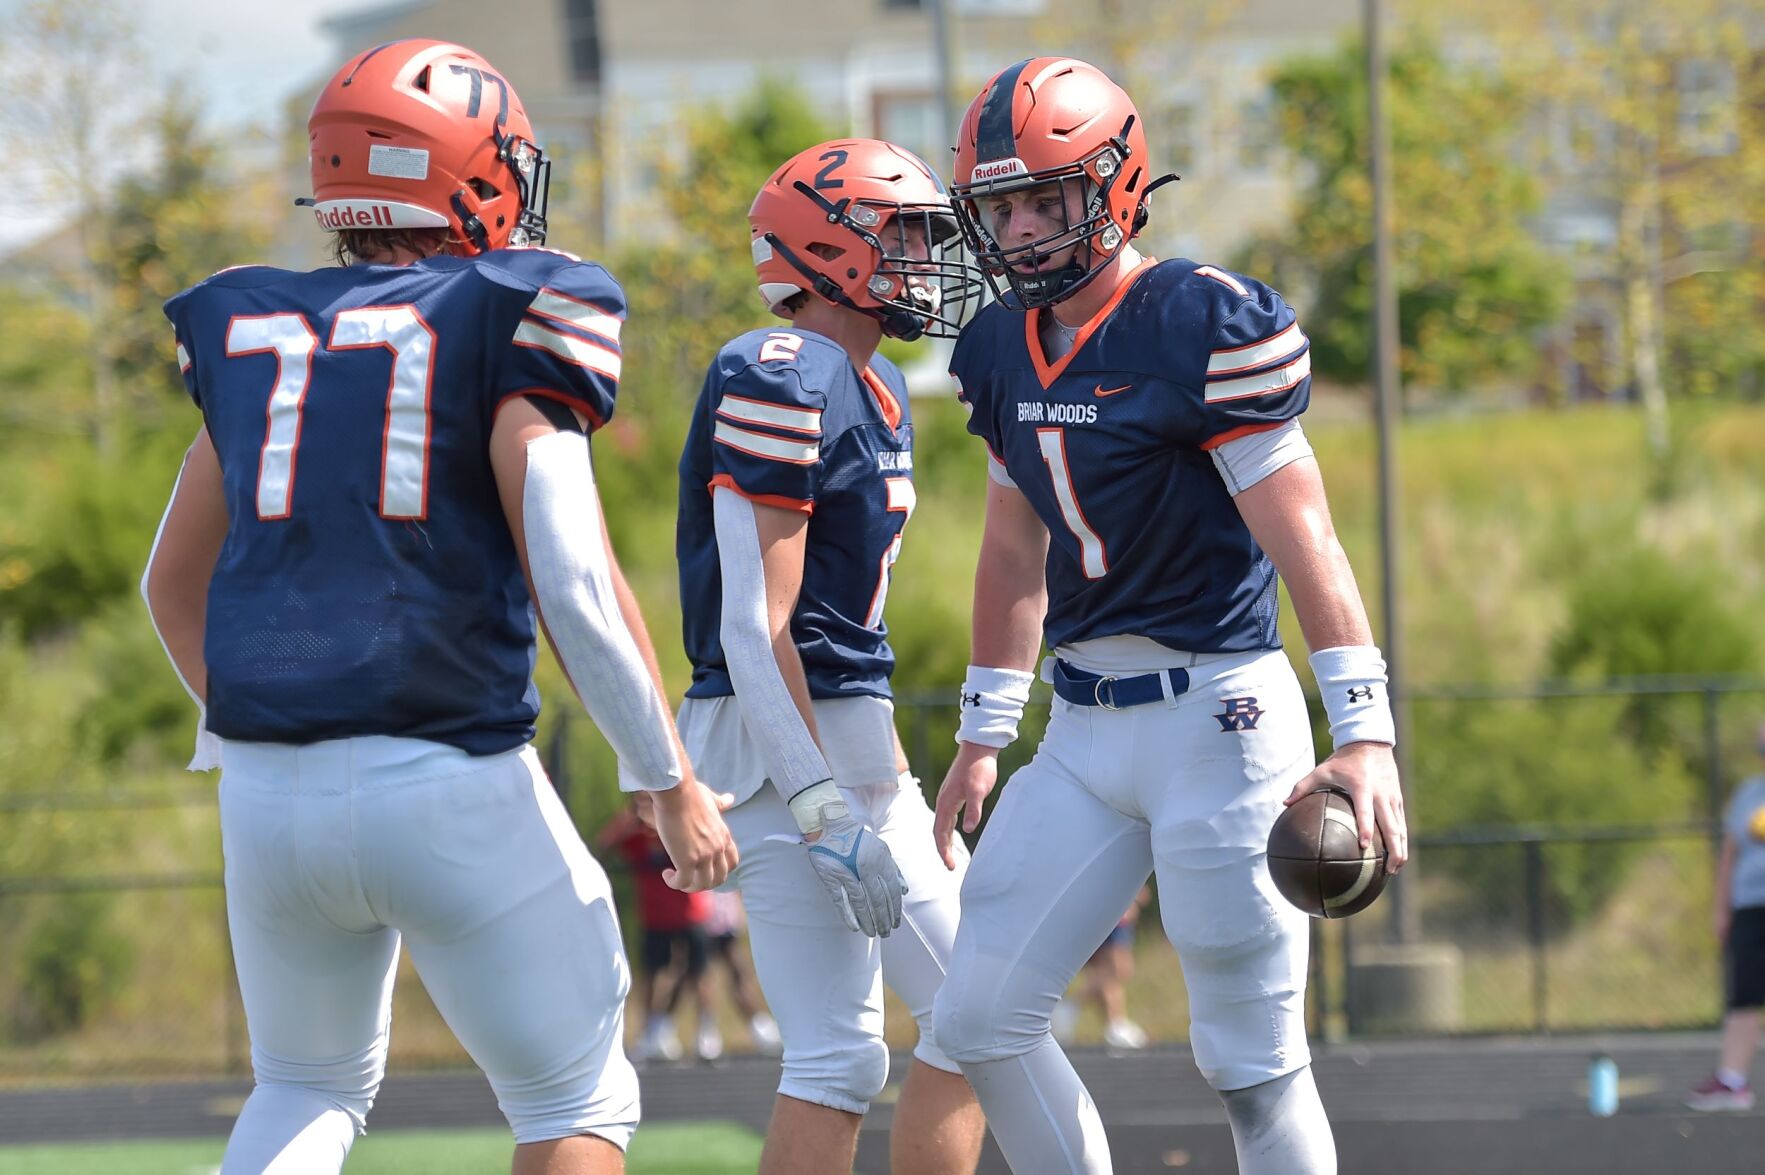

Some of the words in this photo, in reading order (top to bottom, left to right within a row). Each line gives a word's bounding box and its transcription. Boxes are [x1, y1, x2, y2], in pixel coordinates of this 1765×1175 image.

[448, 64, 508, 127] 77
[814, 150, 848, 190] 2
[975, 161, 1017, 180] Riddell
[314, 205, 393, 229] Riddell
[1193, 265, 1250, 297] 1
[758, 332, 804, 363] 2
[225, 303, 438, 521] 77
[1017, 401, 1044, 422] BRIAR
[1045, 402, 1098, 424] WOODS
[1035, 427, 1109, 580] 1
